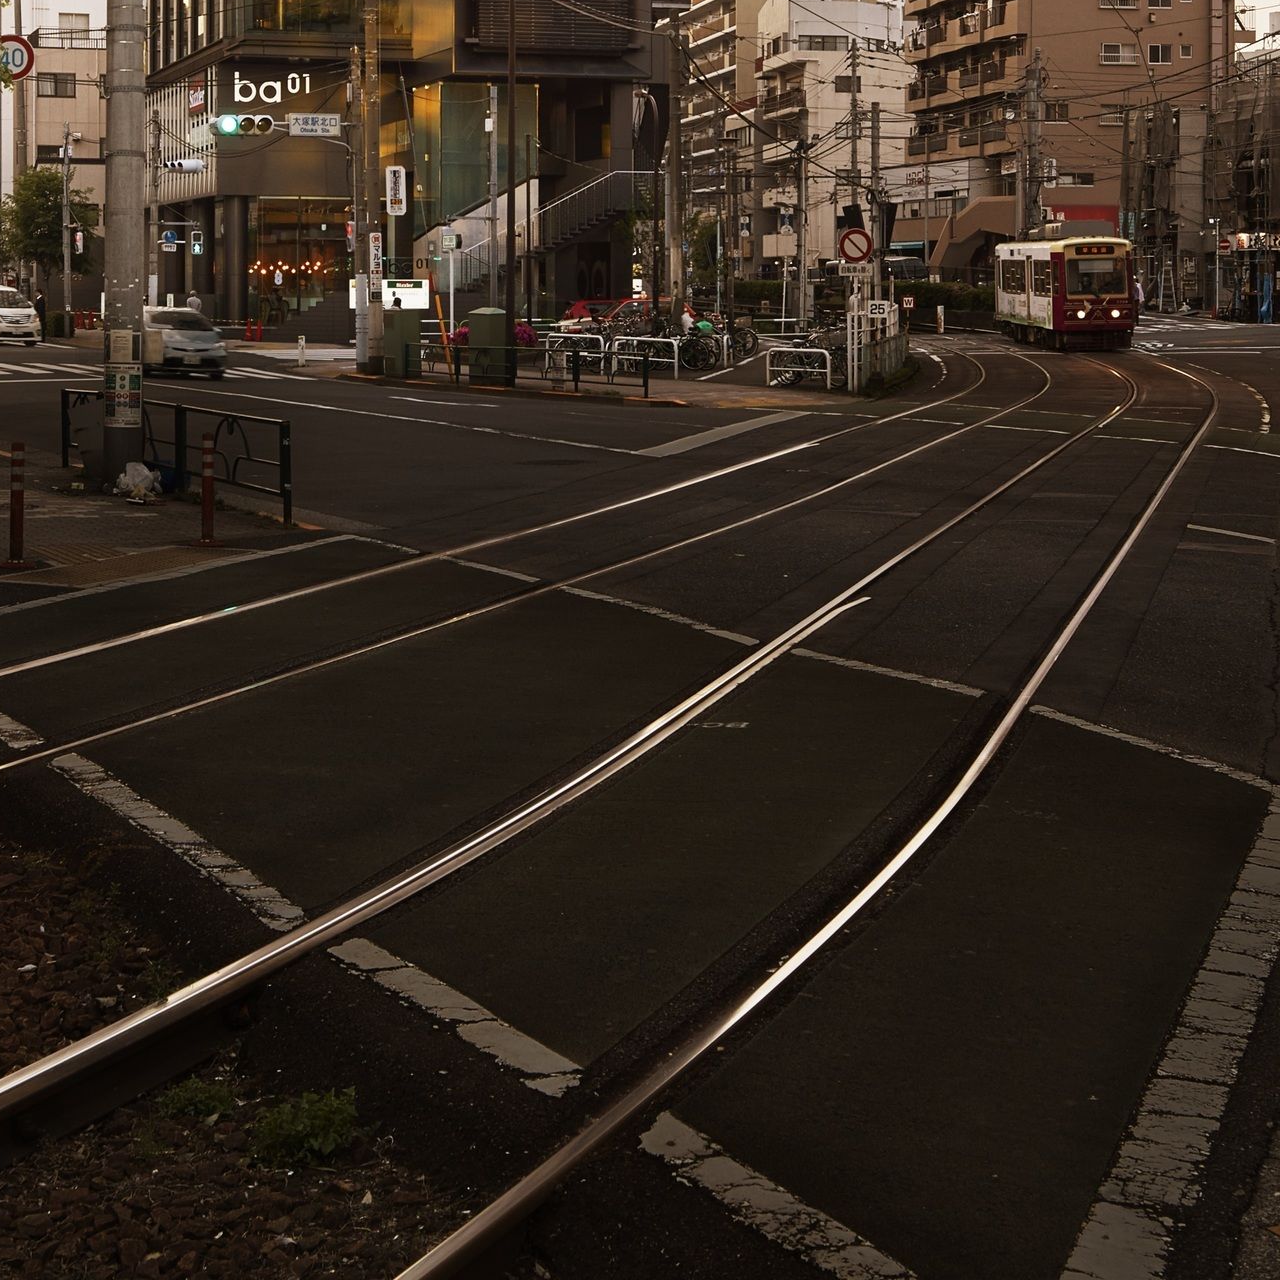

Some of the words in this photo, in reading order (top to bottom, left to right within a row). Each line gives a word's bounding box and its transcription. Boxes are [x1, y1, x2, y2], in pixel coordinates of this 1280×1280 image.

[1, 48, 24, 68] 40
[234, 71, 281, 103] ba
[287, 72, 311, 94] 01
[292, 116, 338, 127] 大塚駅北口
[904, 298, 913, 308] W
[870, 304, 886, 315] 25
